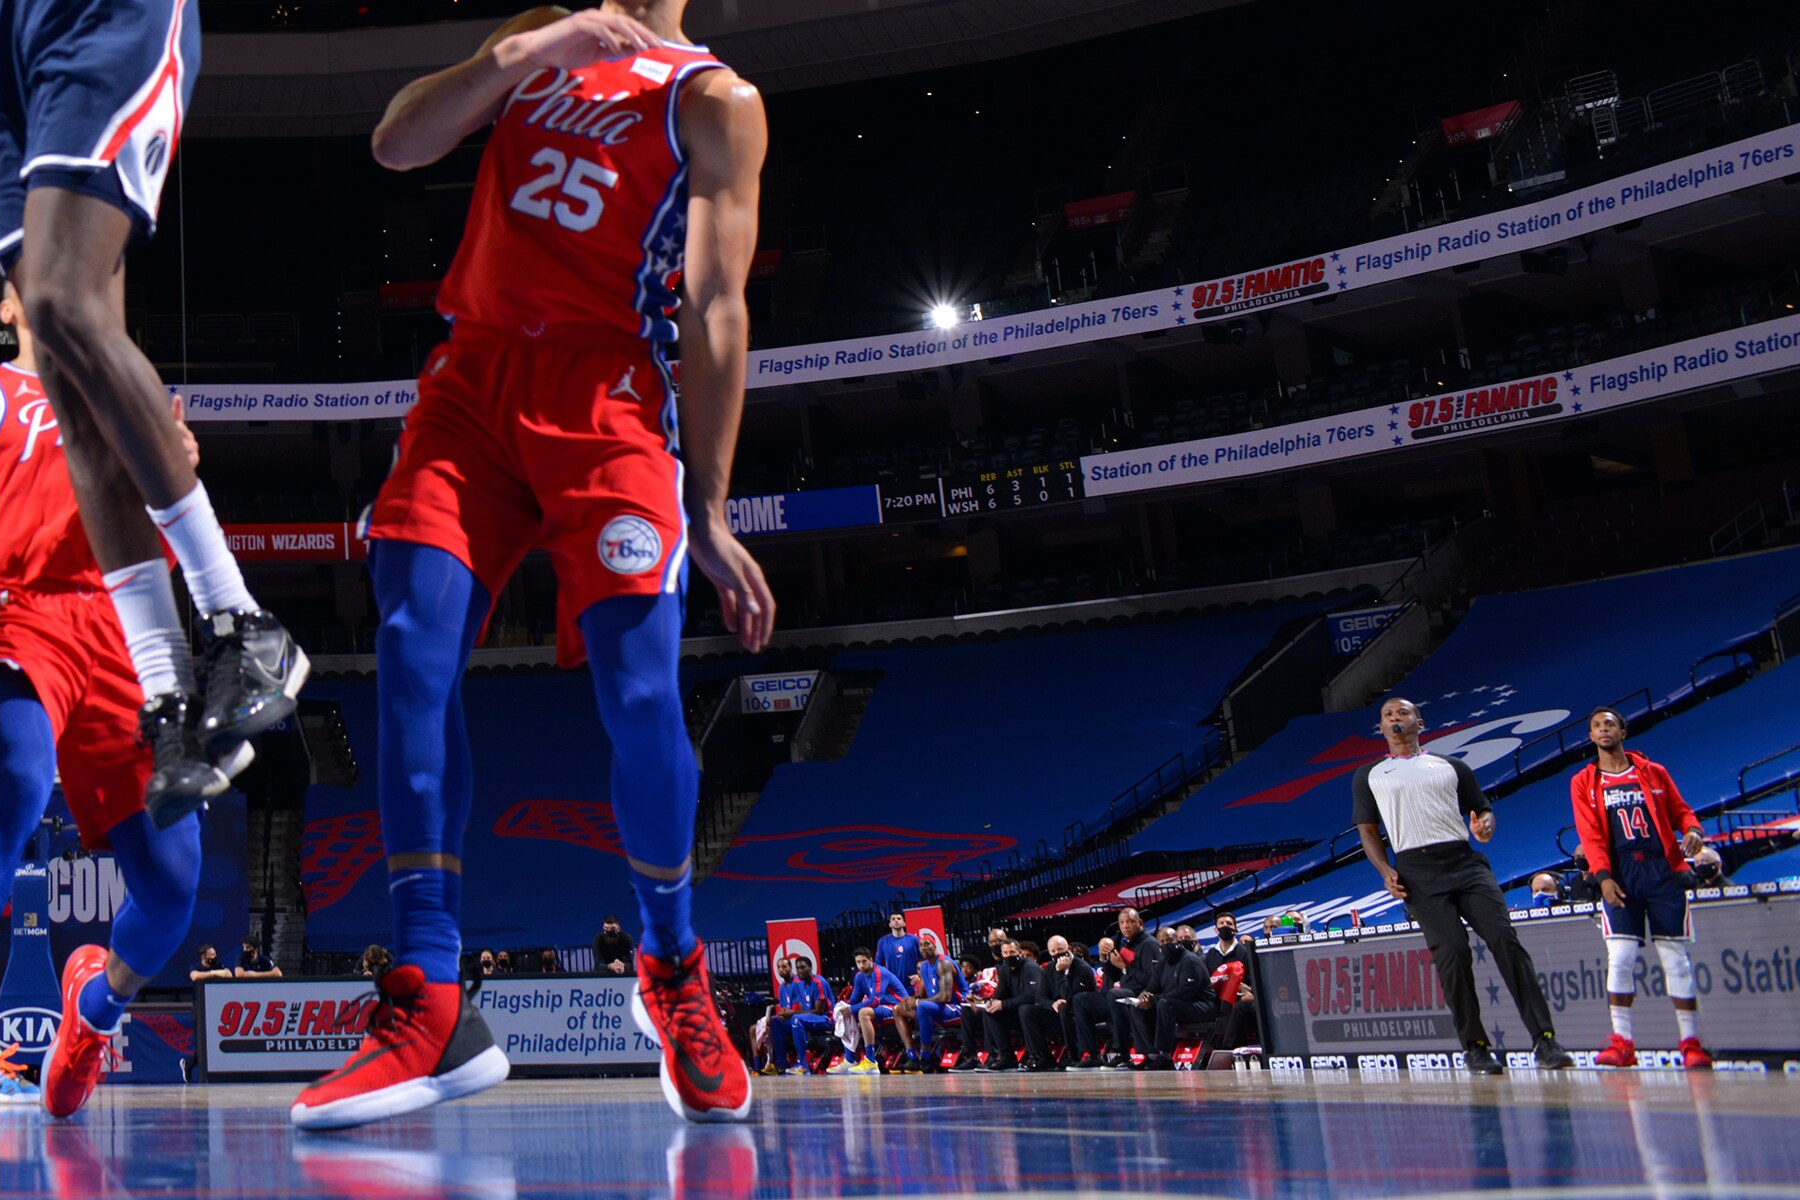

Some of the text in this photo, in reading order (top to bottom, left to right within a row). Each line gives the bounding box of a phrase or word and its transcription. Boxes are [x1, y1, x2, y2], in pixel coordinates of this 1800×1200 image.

[501, 67, 643, 145] Phila
[510, 146, 619, 232] 25
[1355, 141, 1794, 272] Flagship Radio Station of the Philadelphia 76ers
[1192, 257, 1325, 308] 97.5 FANATIC
[1224, 289, 1301, 313] PHILADELPHIA
[758, 302, 1159, 375] Flagship Radio Station the Philadelphia 76ers
[1589, 348, 1729, 394] Flagship Radio
[189, 392, 369, 411] Flagship Radio Station
[1408, 376, 1557, 429] 97.5 FANATIC
[1443, 411, 1530, 433] PHILADELPHIA
[1091, 422, 1374, 482] Station of the Philadelphia 76ers
[885, 493, 936, 509] 7:20 PM
[947, 500, 979, 514] WSH
[271, 533, 335, 550] WIZARDS
[751, 678, 811, 692] GEICO
[1617, 807, 1651, 840] 14
[1305, 955, 1350, 1016] 97.5
[480, 988, 625, 1014] Flagship Radio
[2, 1017, 57, 1042] KIA
[217, 1001, 286, 1036] 97.5
[567, 1011, 621, 1030] of the
[1343, 1019, 1437, 1038] PHILADELPHIA
[506, 1032, 626, 1057] Philadelphia
[1357, 1053, 1450, 1070] GEICO GEICO
